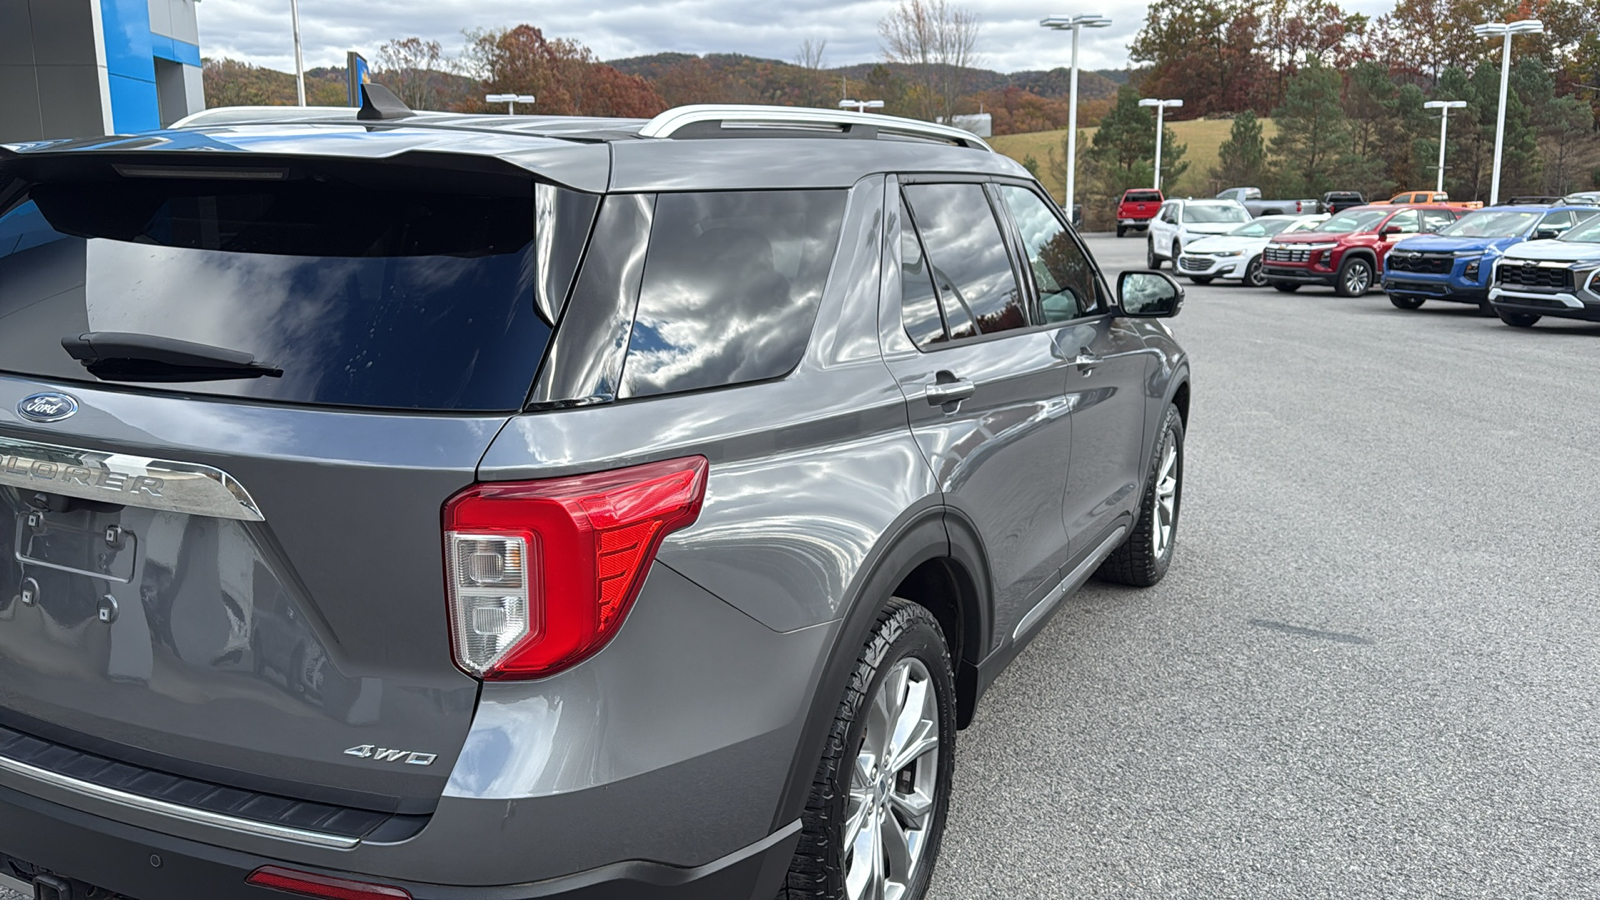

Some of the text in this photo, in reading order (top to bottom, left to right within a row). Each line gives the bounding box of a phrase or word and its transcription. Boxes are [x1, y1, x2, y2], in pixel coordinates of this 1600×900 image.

[26, 396, 62, 414] Ford
[0, 454, 165, 497] LORER
[343, 744, 438, 766] 4WD
